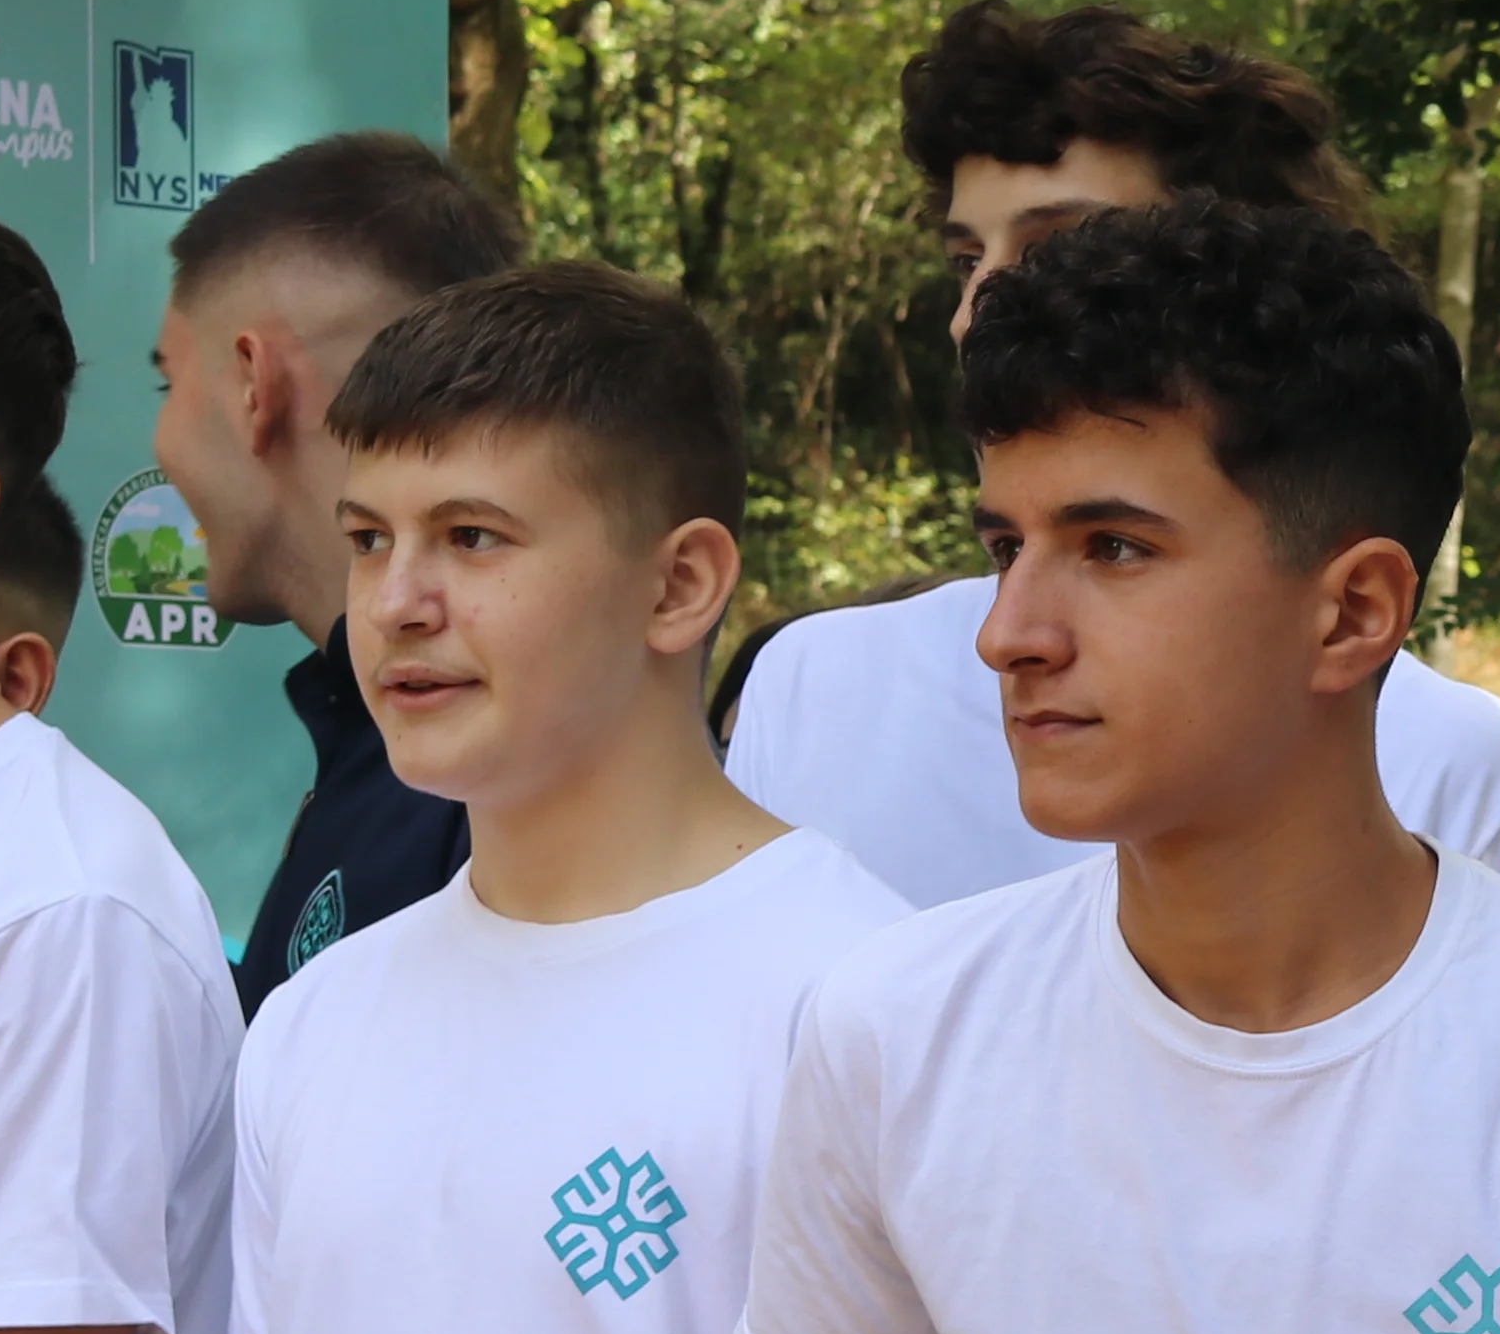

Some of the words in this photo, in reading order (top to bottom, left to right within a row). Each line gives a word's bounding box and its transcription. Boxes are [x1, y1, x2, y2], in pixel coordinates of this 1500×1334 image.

[120, 170, 188, 205] NYS
[199, 173, 232, 194] NE
[123, 602, 219, 644] APR
